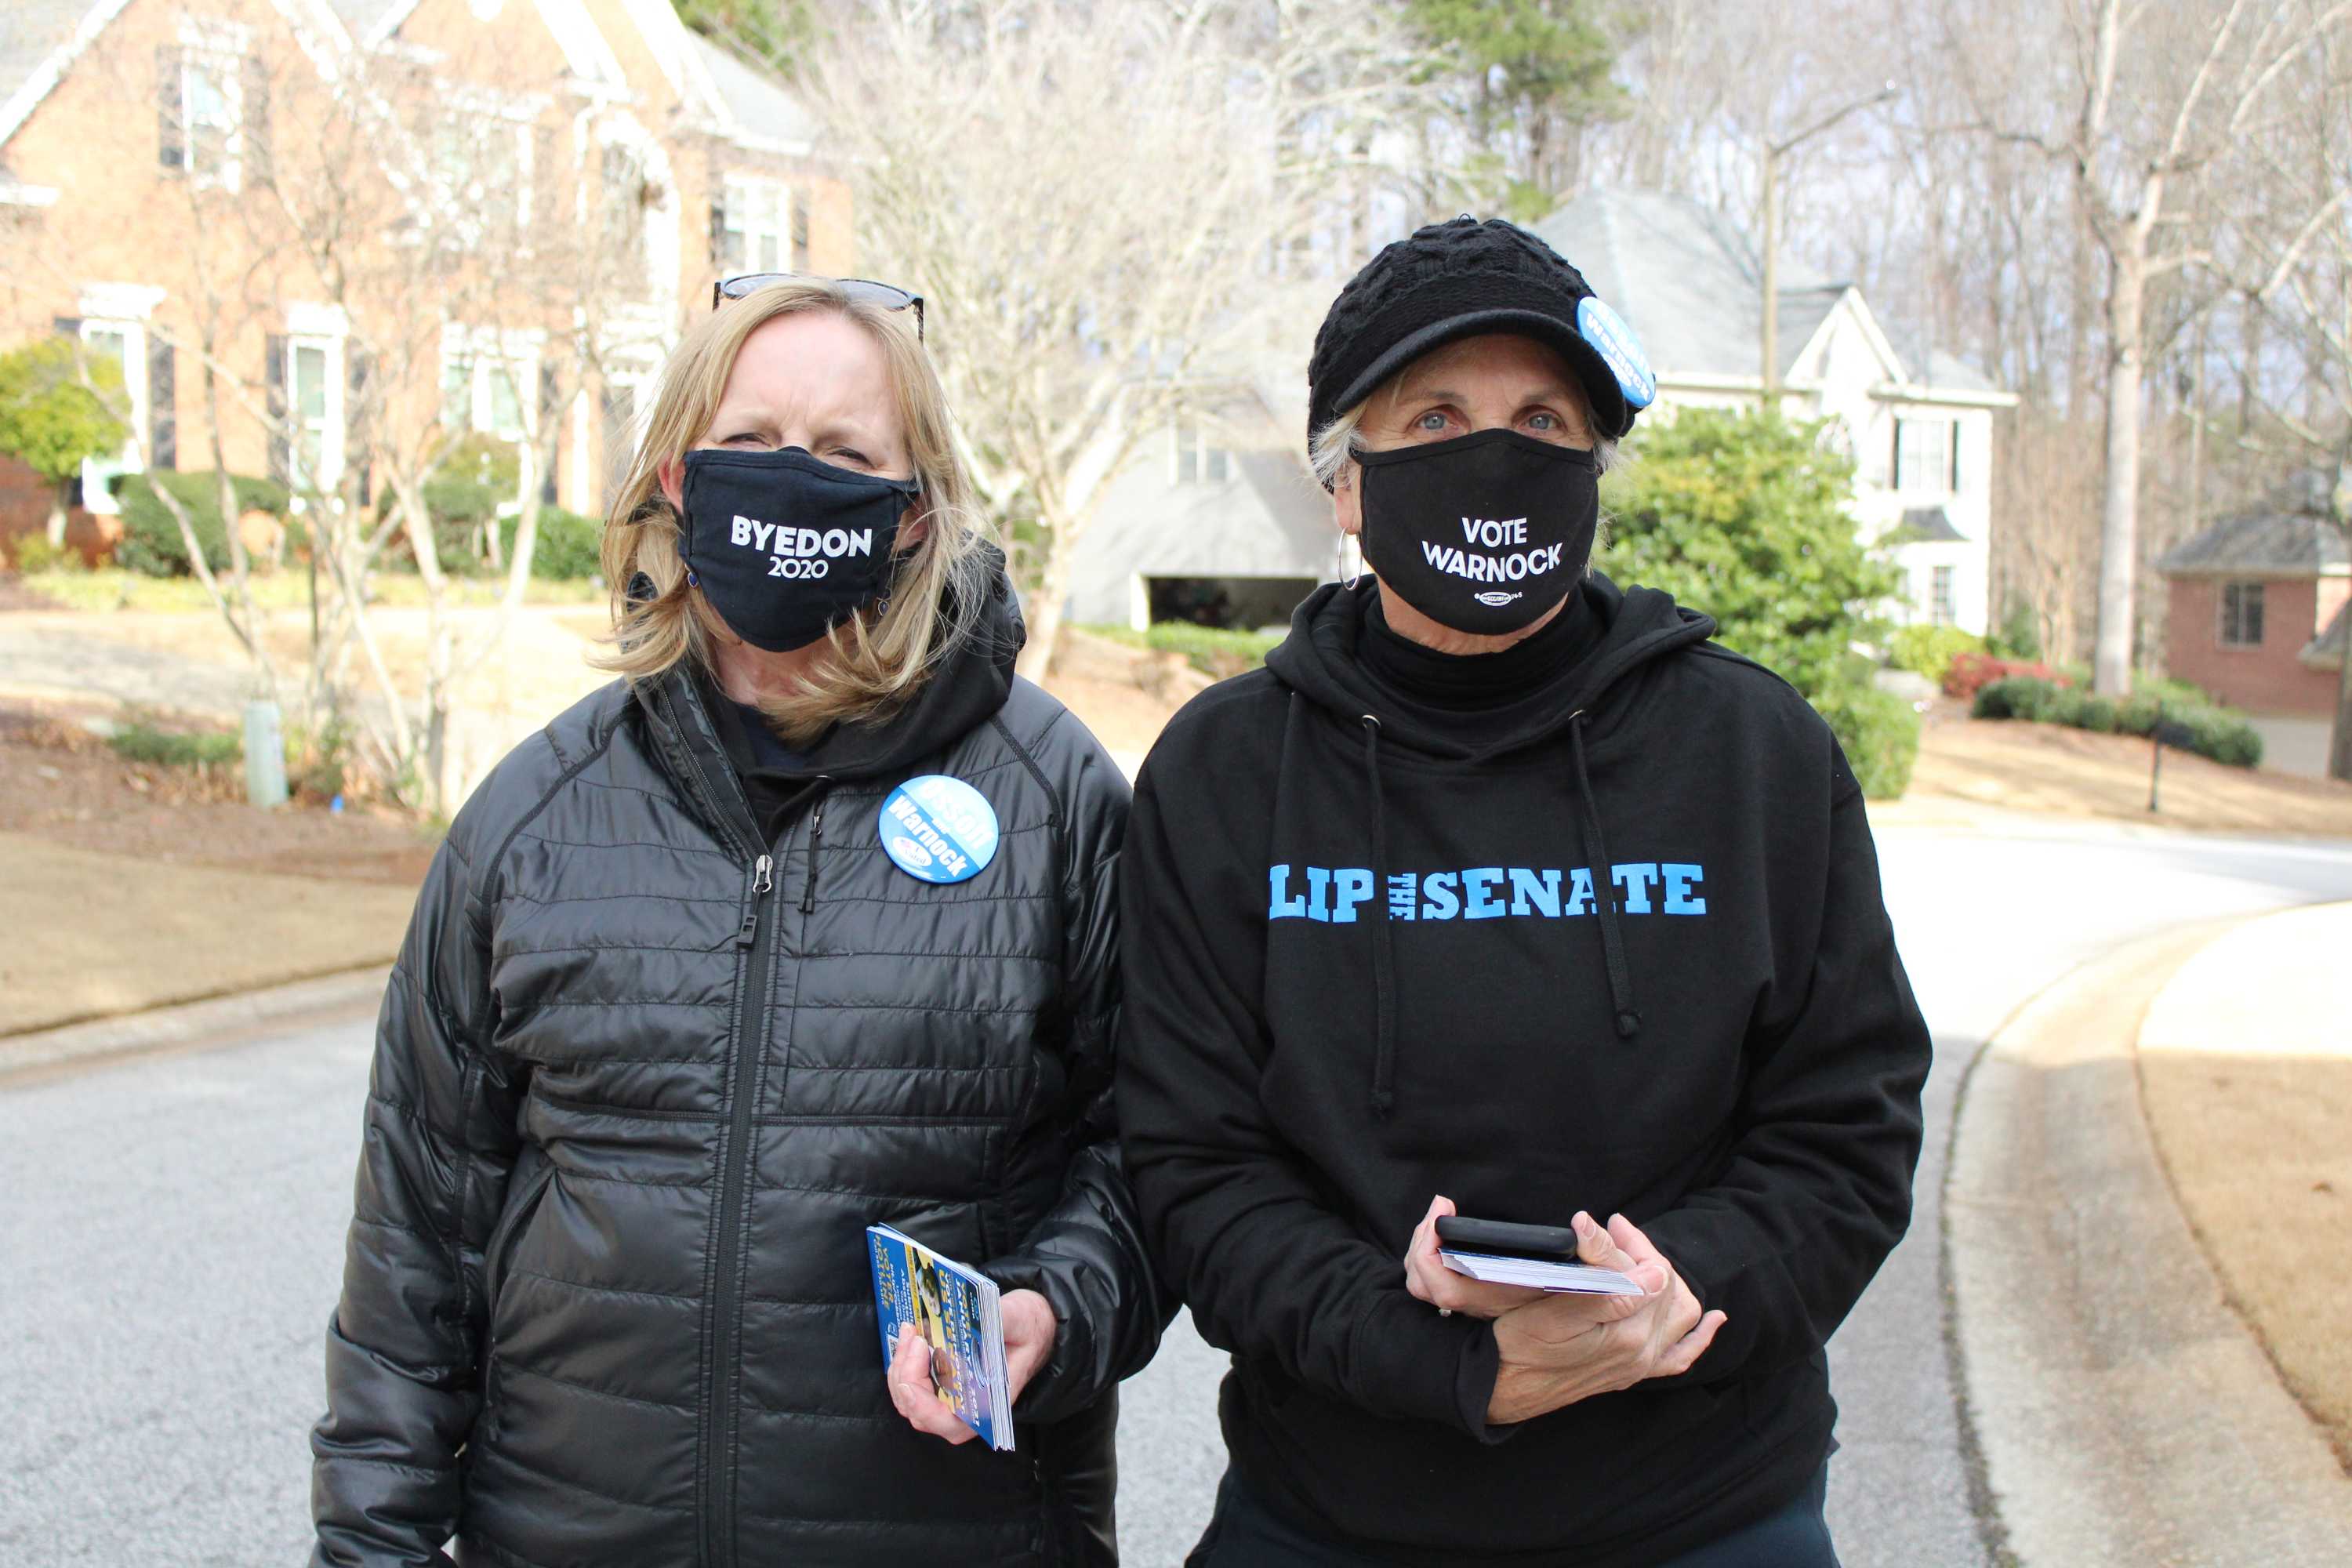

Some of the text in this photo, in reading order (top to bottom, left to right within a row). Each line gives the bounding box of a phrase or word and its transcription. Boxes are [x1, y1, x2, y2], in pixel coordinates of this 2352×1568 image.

[731, 515, 873, 557] BYEDON
[1461, 517, 1527, 547] VOTE
[768, 556, 829, 579] 2020
[1421, 541, 1563, 583] WARNOCK
[887, 794, 968, 877] Warnock
[1387, 873, 1417, 921] THE
[1422, 863, 1706, 920] SENATE
[945, 1272, 954, 1318] VOTE
[955, 1278, 973, 1370] JANUARY
